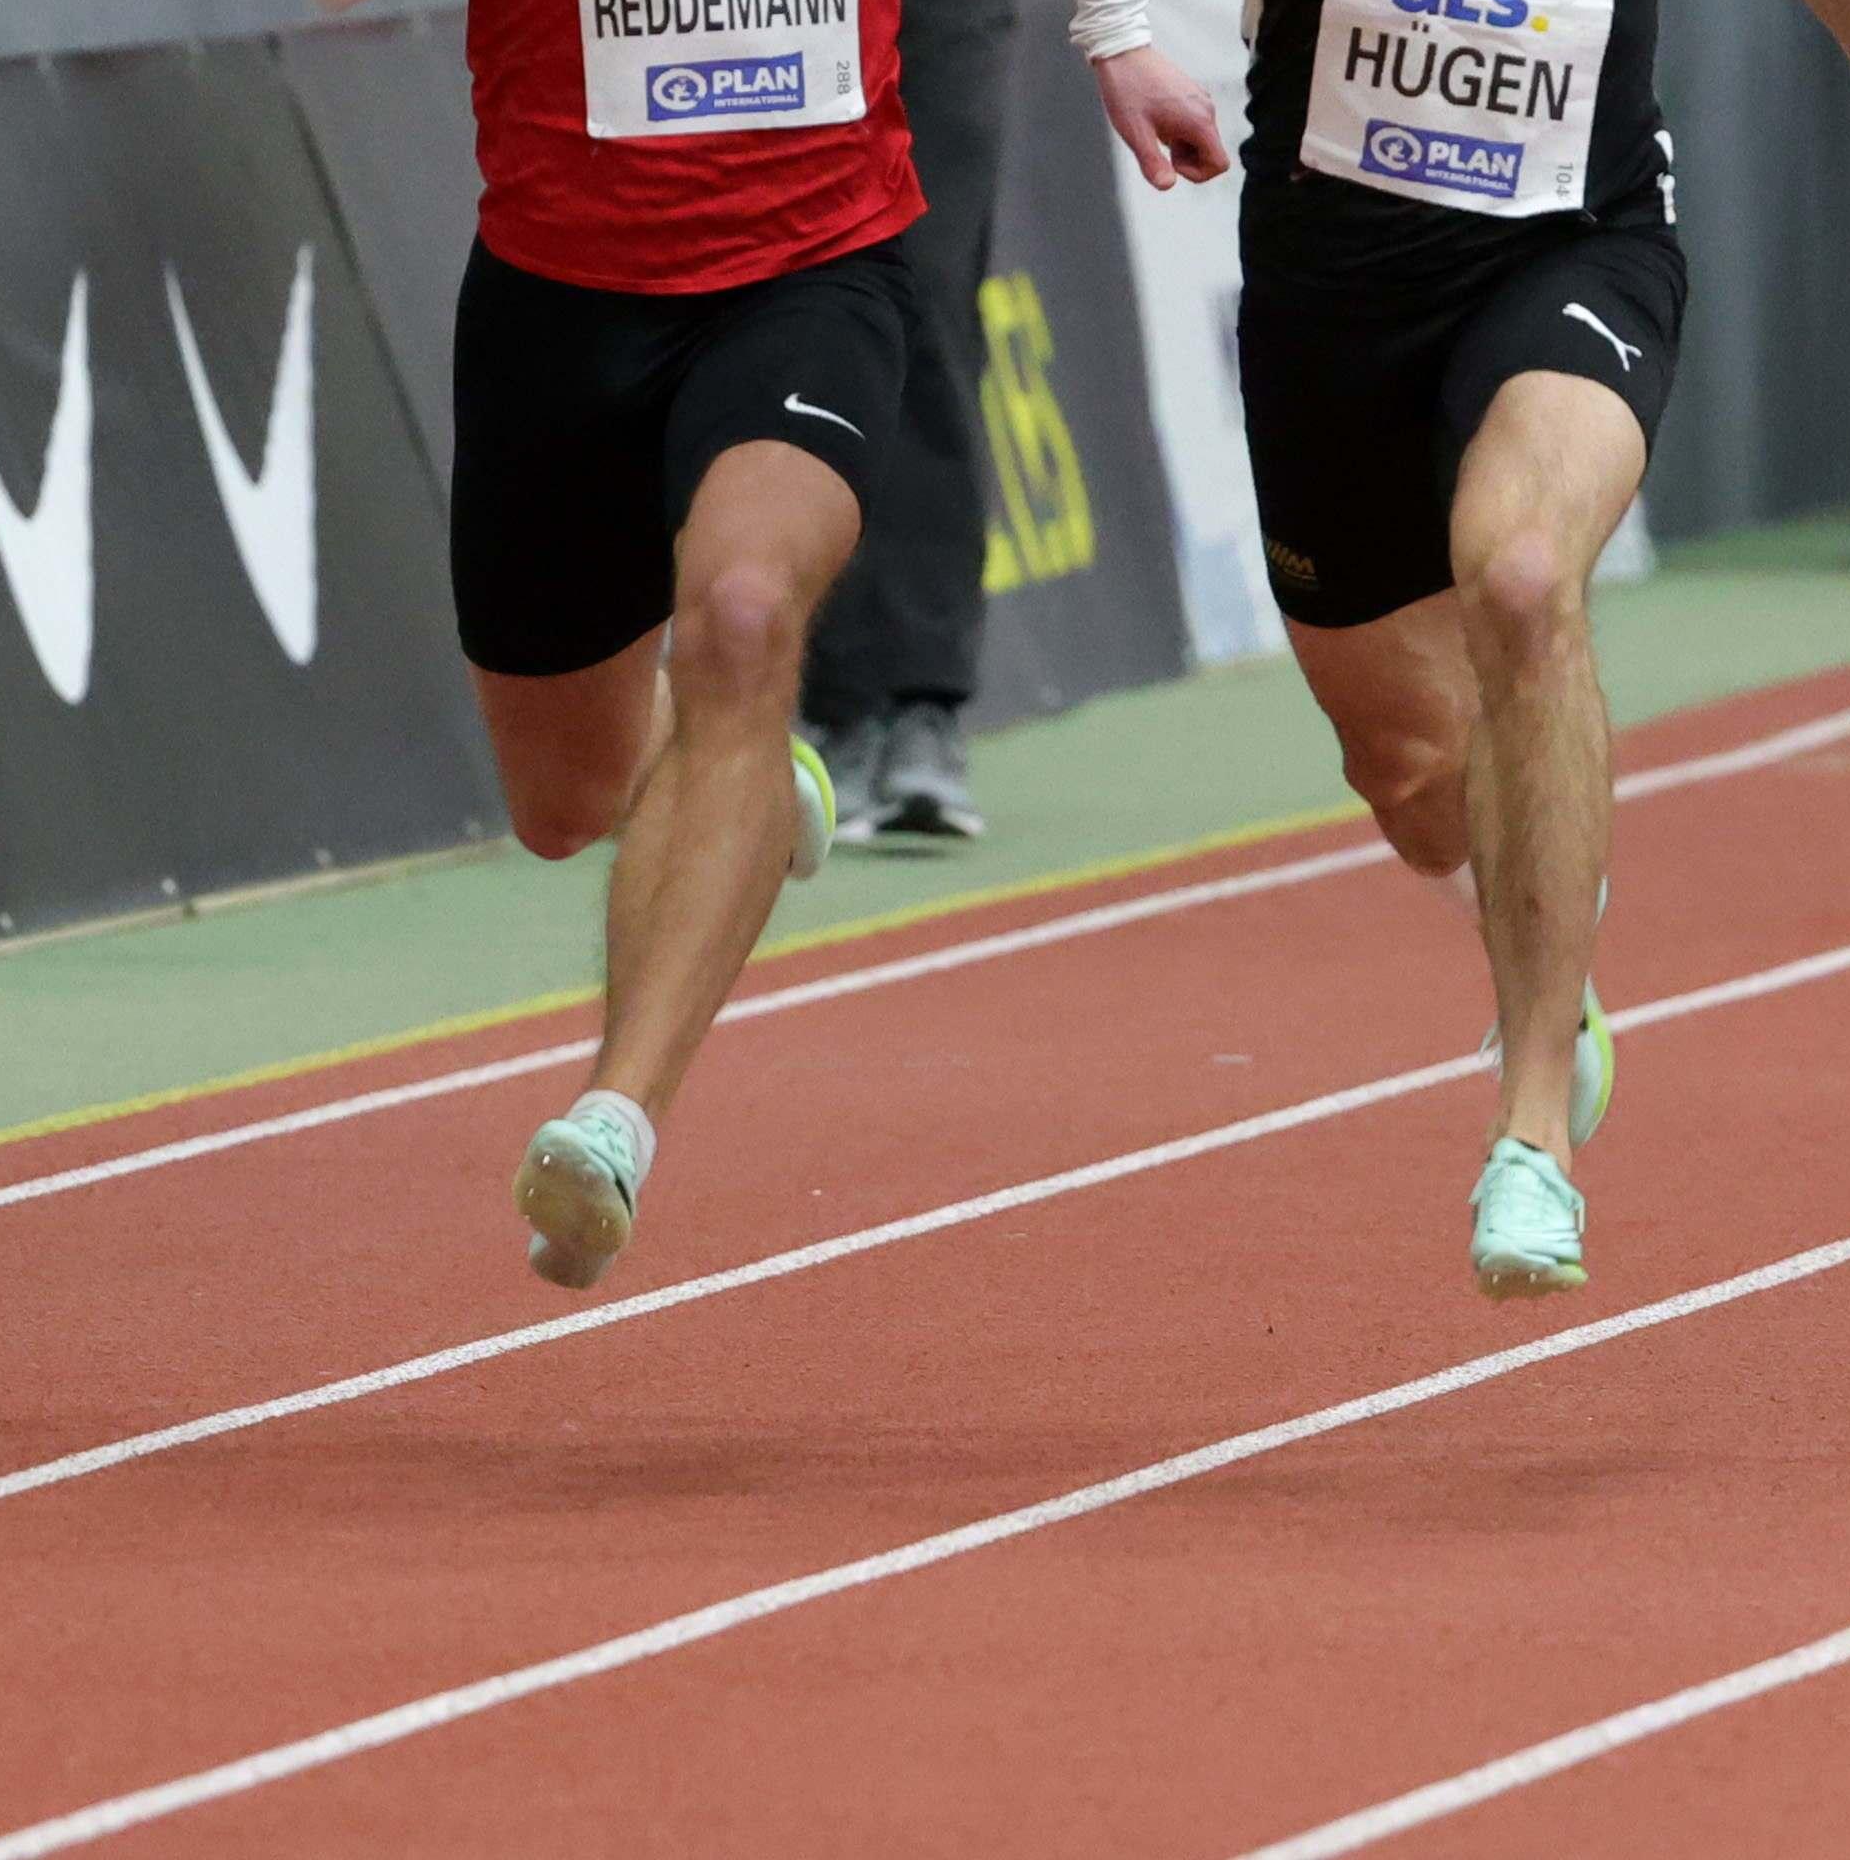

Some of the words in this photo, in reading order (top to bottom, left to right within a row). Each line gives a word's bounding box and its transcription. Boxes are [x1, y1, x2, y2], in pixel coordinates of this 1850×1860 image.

[713, 65, 798, 94] PLAN
[1344, 20, 1573, 121] HÜGEN
[1427, 140, 1517, 179] PLAN
